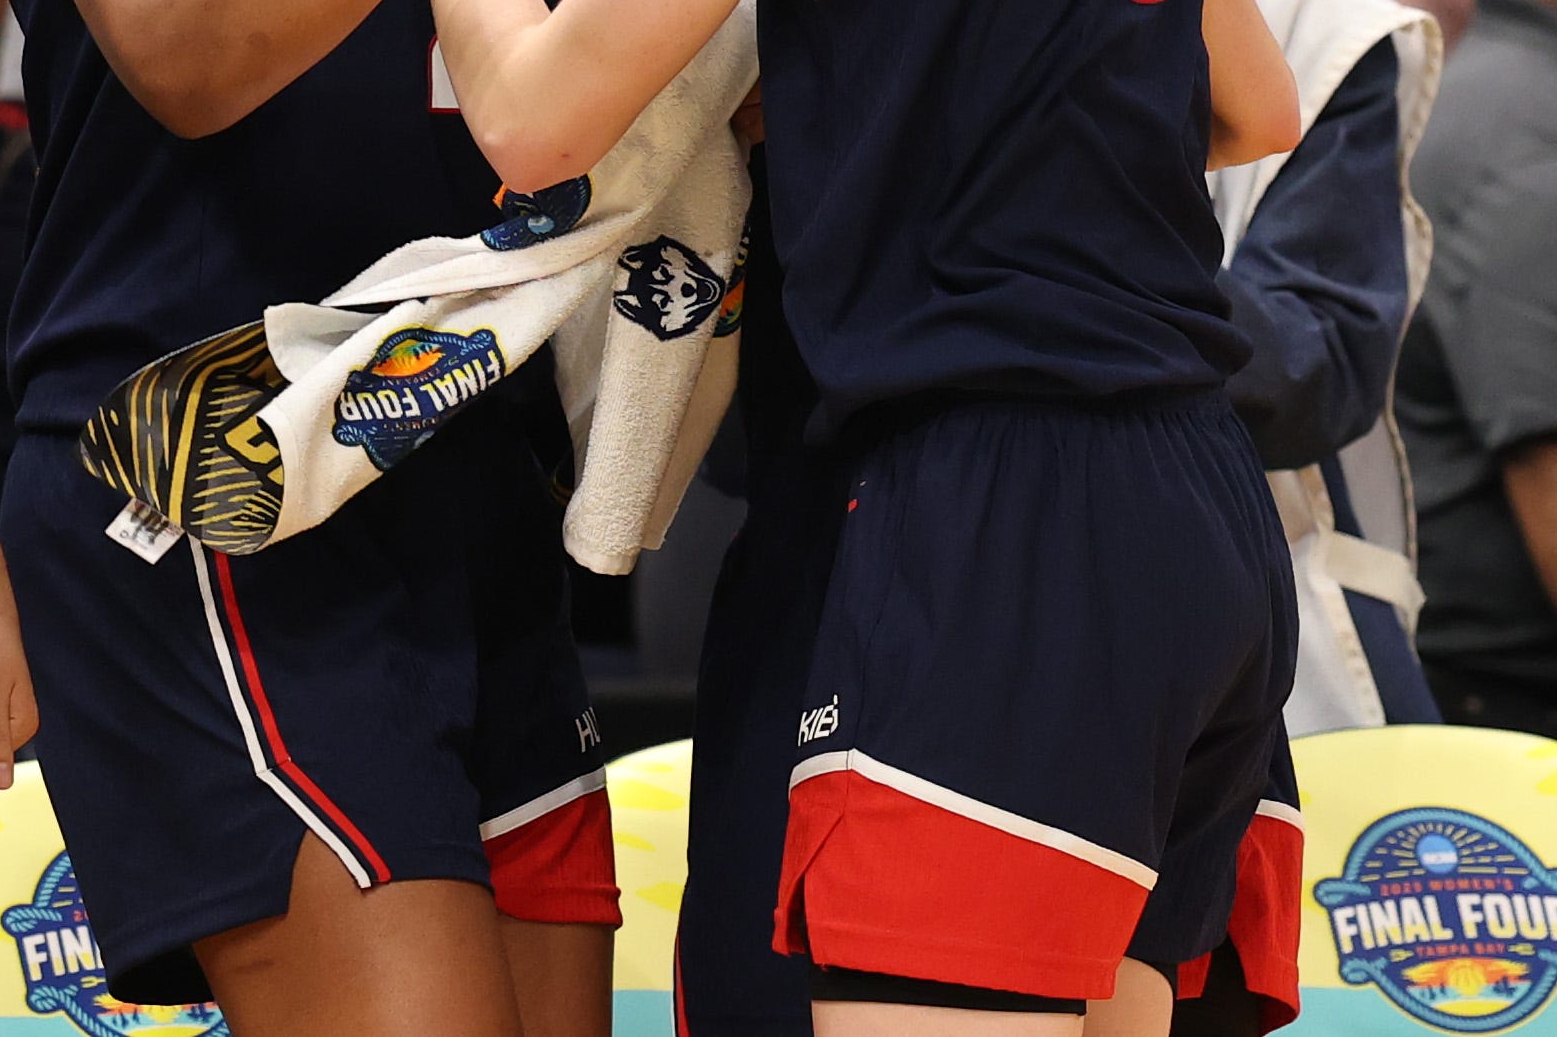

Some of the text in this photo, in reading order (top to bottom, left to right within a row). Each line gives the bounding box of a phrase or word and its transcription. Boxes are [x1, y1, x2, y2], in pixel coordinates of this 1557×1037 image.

[339, 349, 502, 422] FINAL FOUR
[1332, 894, 1454, 955] FINAL
